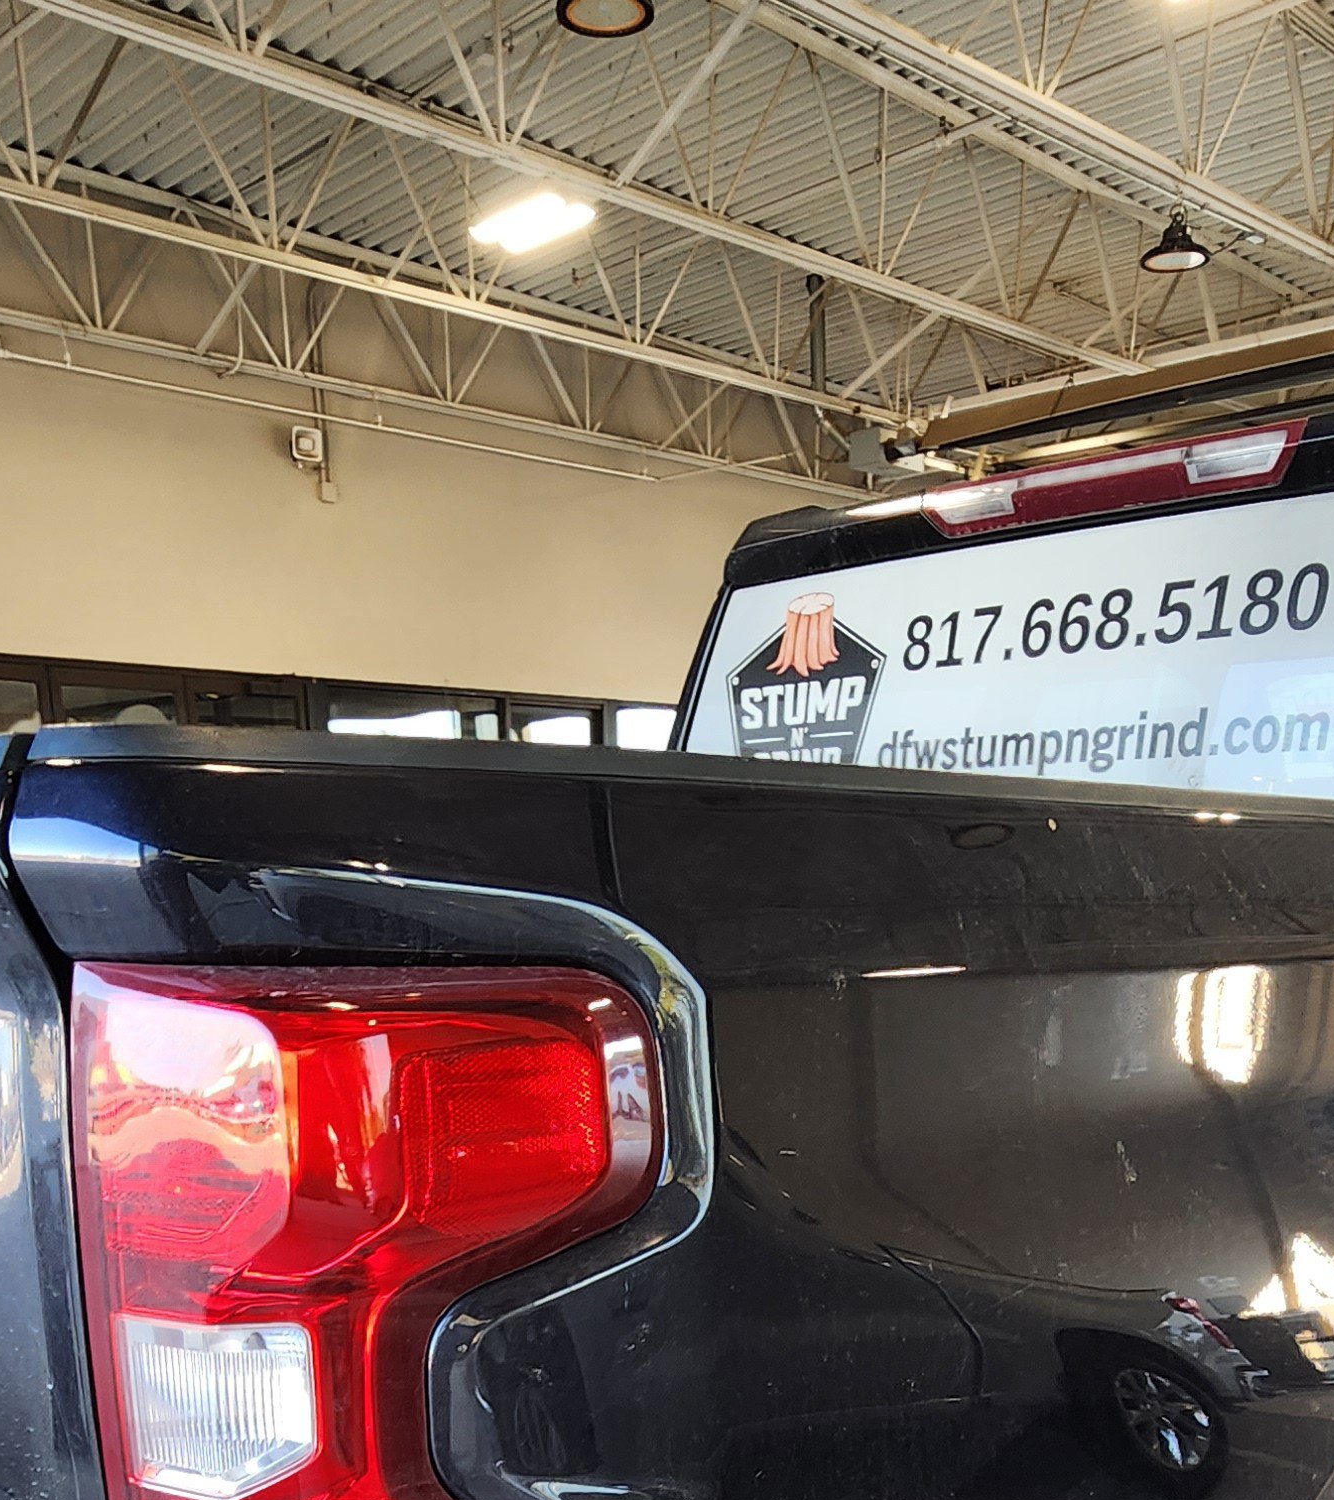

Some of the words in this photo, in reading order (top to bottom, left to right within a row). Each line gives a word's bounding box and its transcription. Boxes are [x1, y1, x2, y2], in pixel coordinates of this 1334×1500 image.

[902, 562, 1330, 672] 817.668.5180
[740, 675, 867, 730] STUMP
[876, 707, 1331, 776] dfwstumpngrind.com
